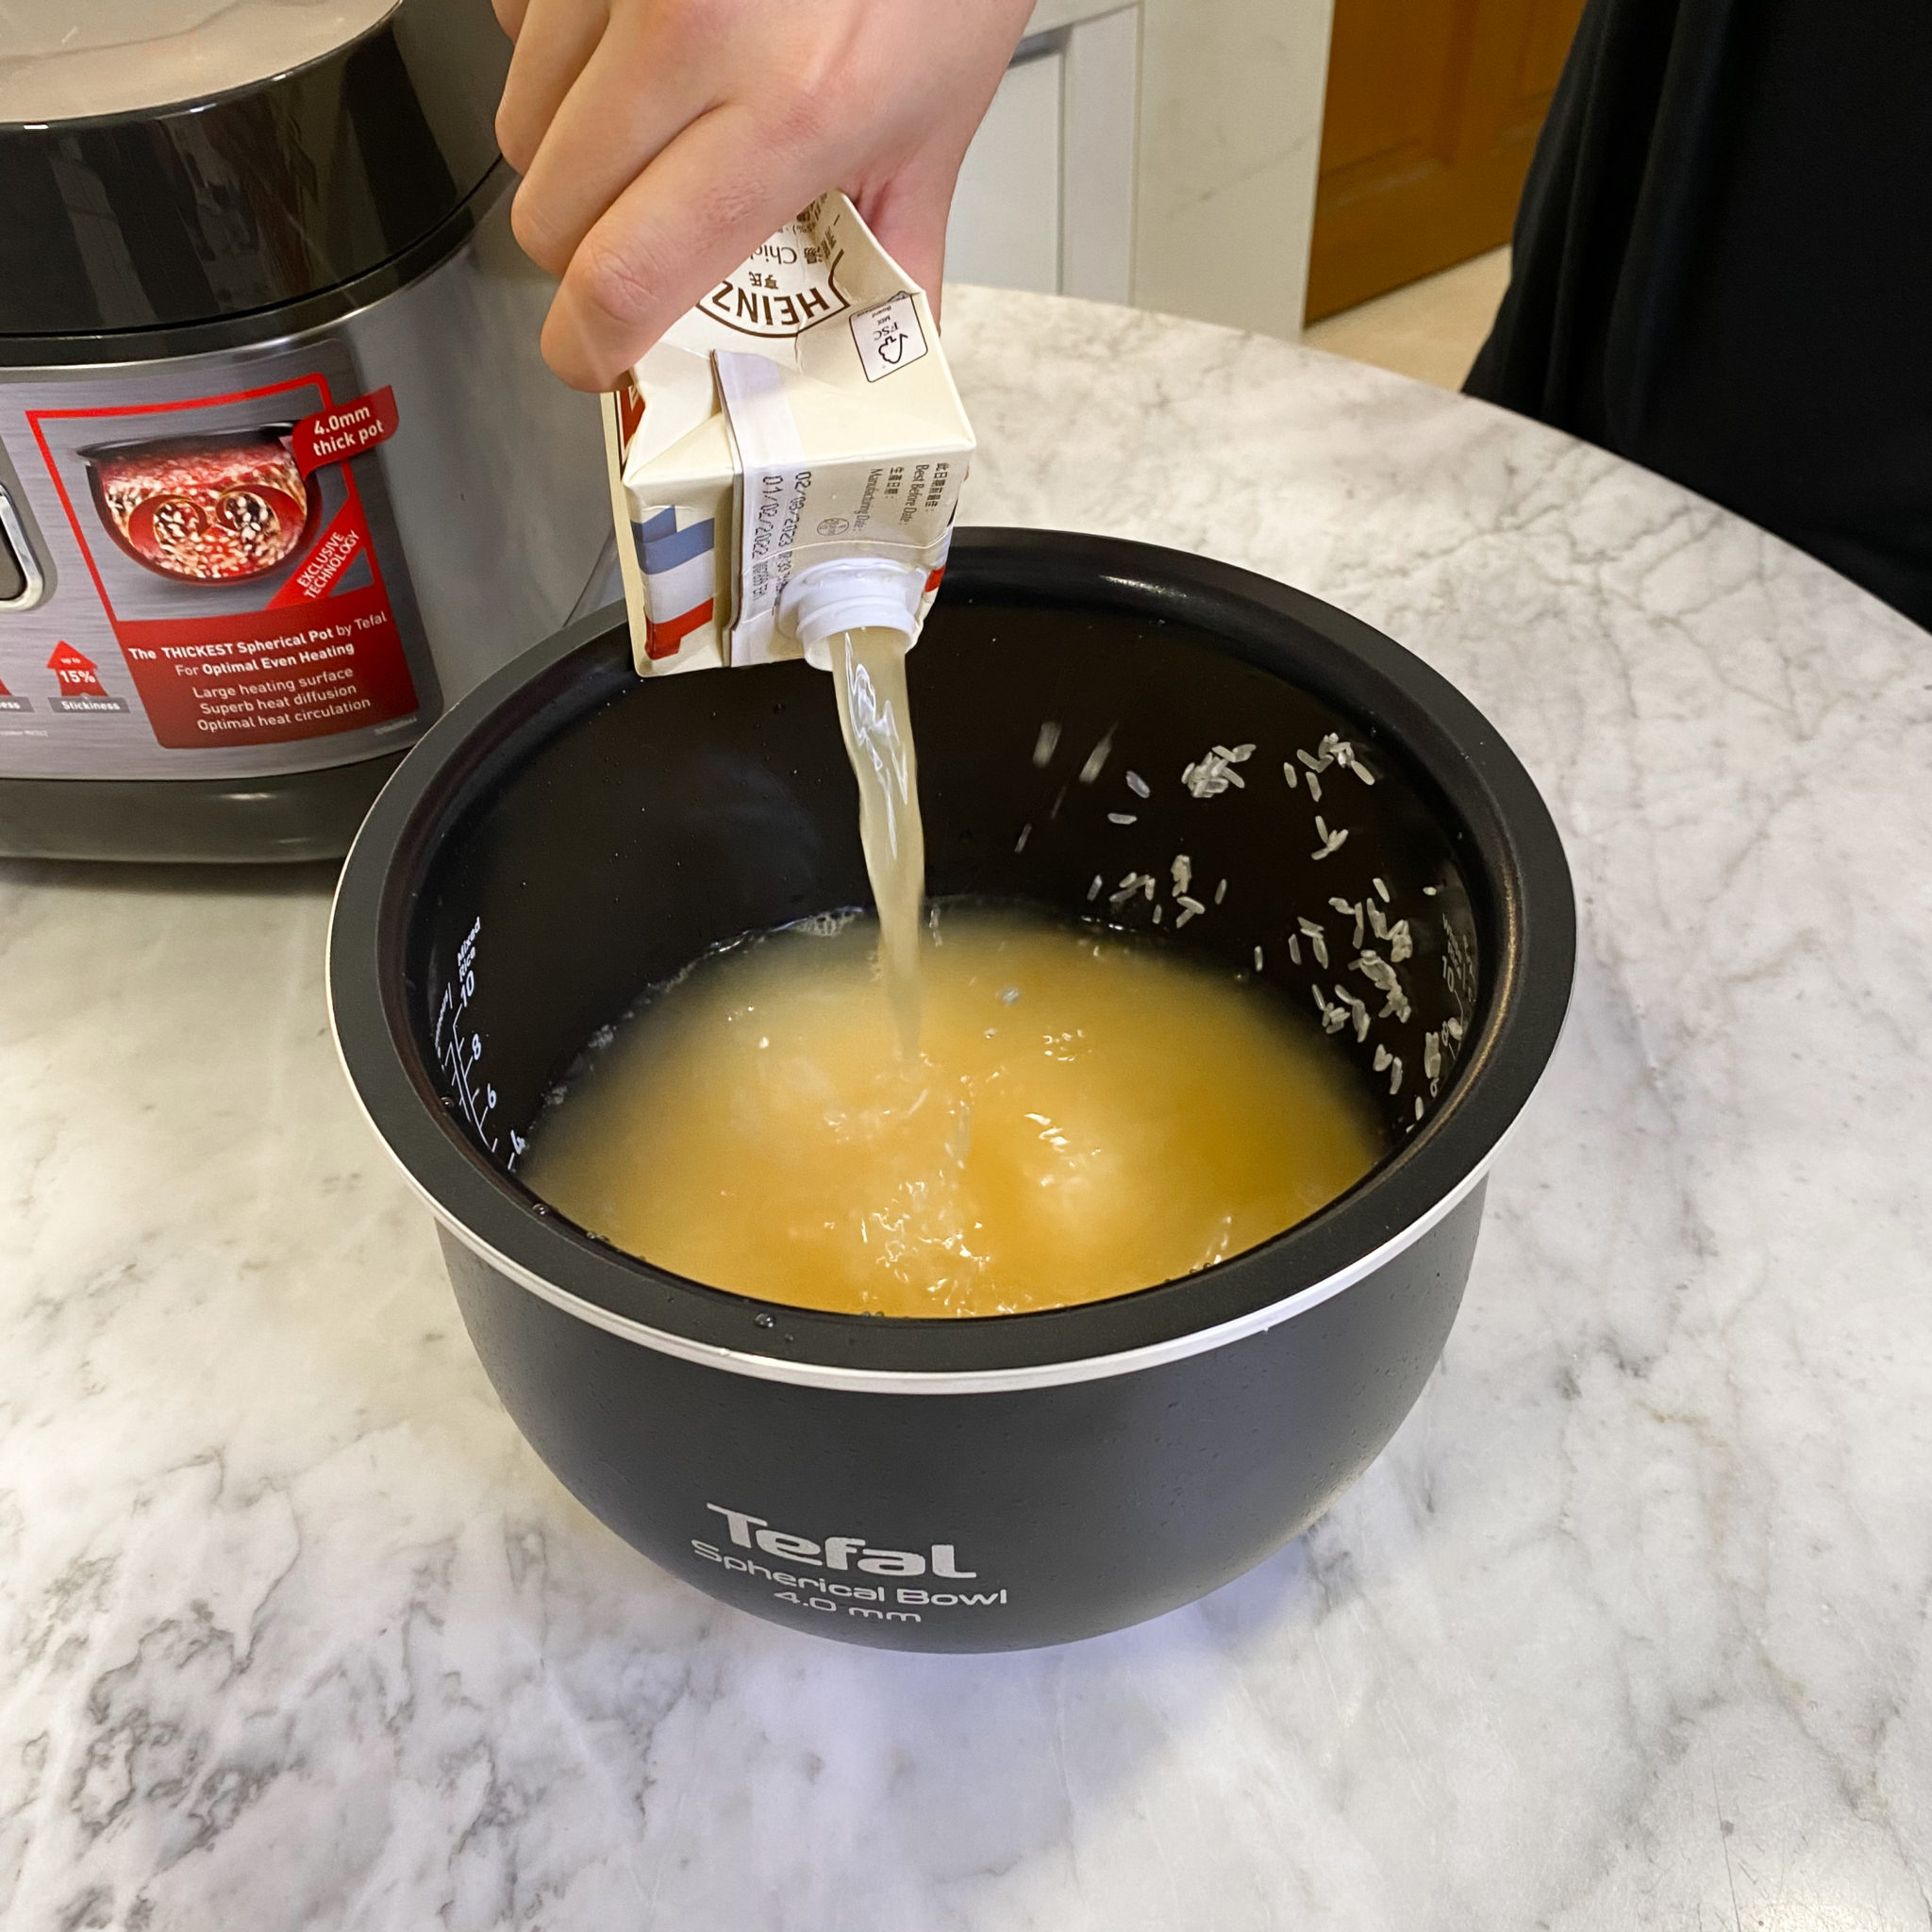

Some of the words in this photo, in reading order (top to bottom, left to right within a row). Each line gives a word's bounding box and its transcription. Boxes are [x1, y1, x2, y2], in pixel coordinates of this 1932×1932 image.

[750, 244, 798, 264] Chic
[712, 282, 829, 325] HEINZ
[874, 322, 899, 341] FSC
[313, 406, 371, 435] 4.0mm
[313, 432, 356, 457] thick
[358, 419, 384, 445] pot
[912, 464, 929, 482] Best
[854, 468, 884, 515] Manufacturing
[906, 484, 924, 506] Before
[296, 531, 345, 588] EXCLUSIVE
[303, 529, 359, 599] TECHNOLOGY
[128, 647, 157, 660] The
[161, 643, 233, 659] THICKEST
[237, 633, 307, 656] Spherical
[308, 628, 333, 642] Pot
[336, 623, 352, 638] by
[354, 610, 388, 631] Tefal
[175, 665, 200, 676] For
[202, 657, 258, 676] Optimal
[261, 655, 296, 669] Even
[299, 642, 355, 663] Heating
[59, 670, 96, 683] 15%
[192, 686, 236, 701] Large
[239, 678, 295, 695] heating
[298, 667, 354, 687] surface
[61, 701, 121, 710] Stickiness
[196, 716, 256, 733] Optimal
[258, 713, 291, 726] heat
[294, 697, 371, 723] circulation
[200, 701, 254, 717] Superb
[257, 697, 290, 710] heat
[293, 684, 357, 706] diffusion
[460, 970, 475, 1008] 10
[472, 1033, 481, 1060] 8
[487, 1083, 496, 1108] 6
[707, 1503, 976, 1578] Tefal
[691, 1540, 885, 1602] Spherical
[897, 1589, 1007, 1606] Bowl
[774, 1591, 837, 1612] 4.0
[849, 1606, 921, 1623] mm
